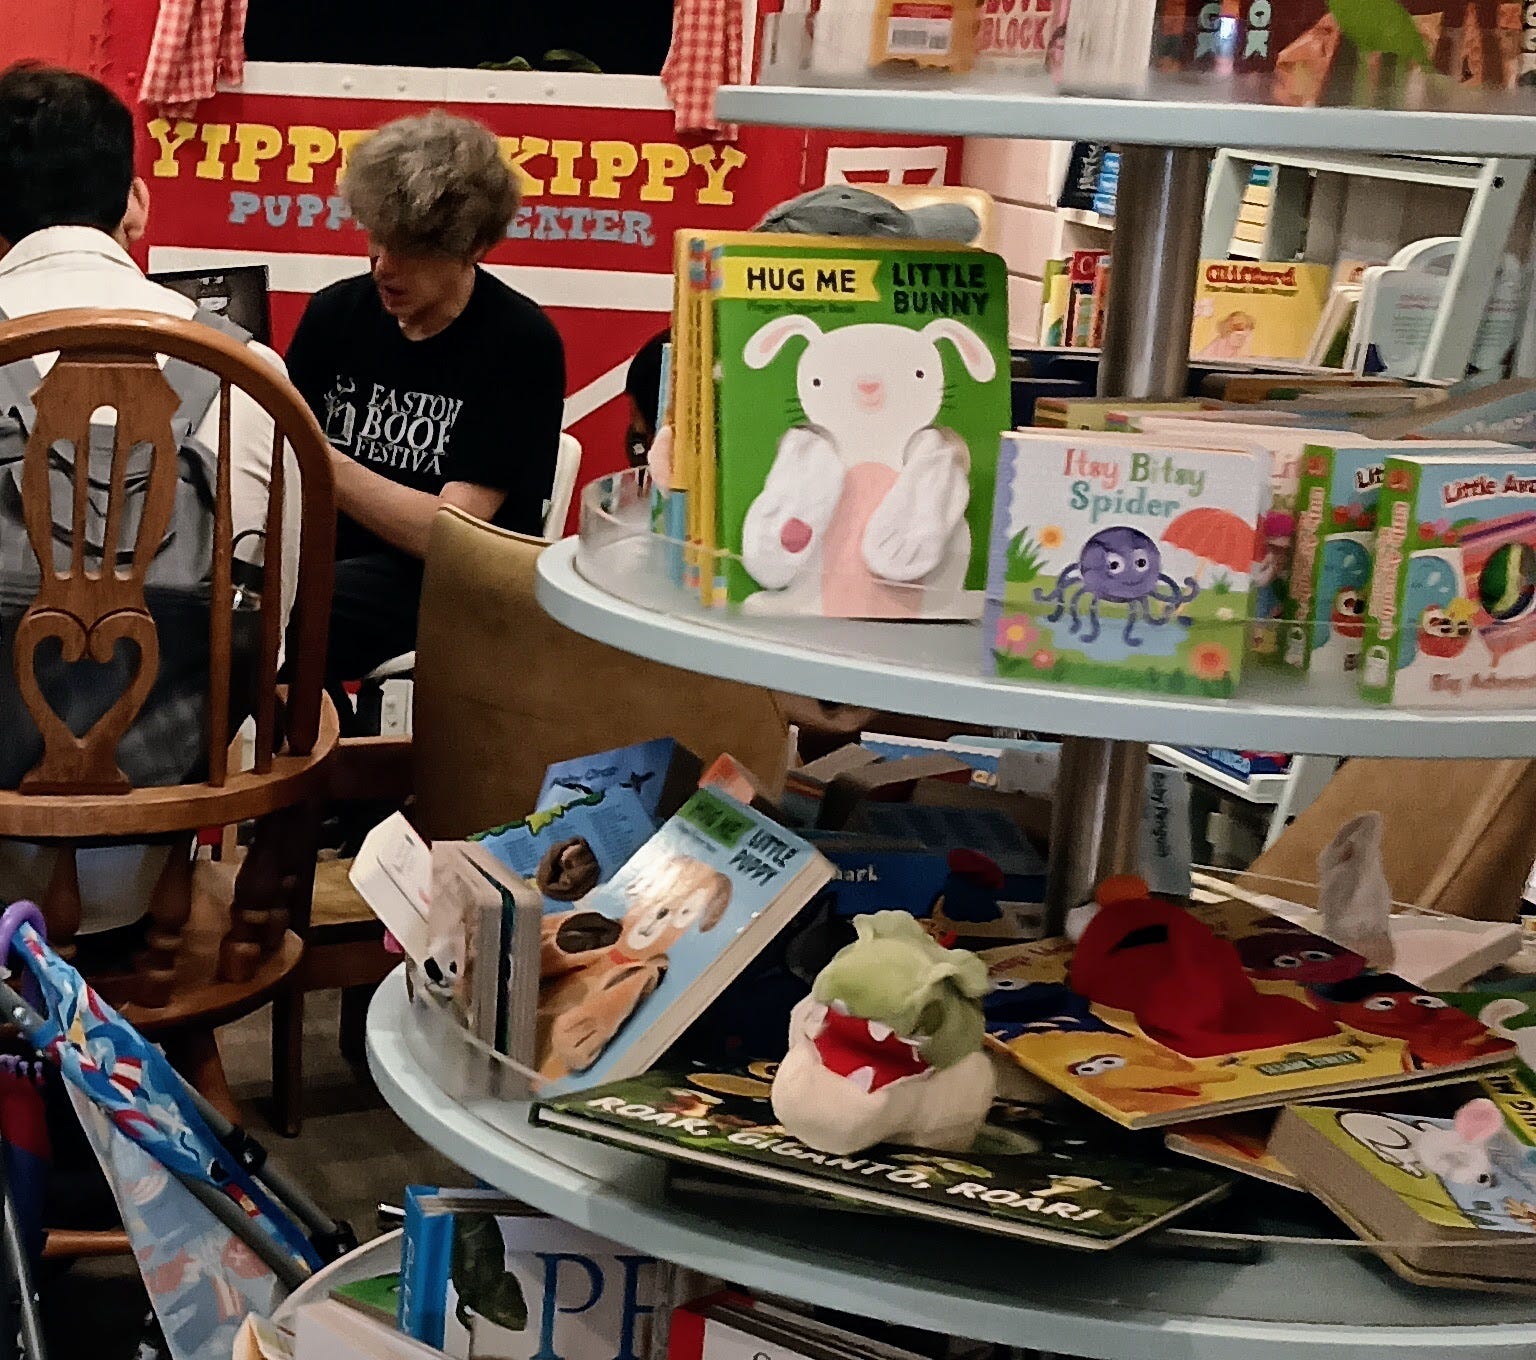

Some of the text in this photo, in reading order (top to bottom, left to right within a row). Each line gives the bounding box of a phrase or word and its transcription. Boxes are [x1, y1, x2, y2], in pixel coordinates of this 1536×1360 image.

[507, 205, 655, 246] EATER
[747, 266, 856, 293] HUG ME
[891, 261, 986, 289] LITTLE
[893, 289, 990, 315] BUNNY
[367, 382, 464, 429] EASTON
[1063, 448, 1207, 498] Itsy Bitsy
[1069, 480, 1181, 524] Spider
[727, 1130, 932, 1190] GIGANTO,
[945, 1181, 1103, 1222] ROAR!
